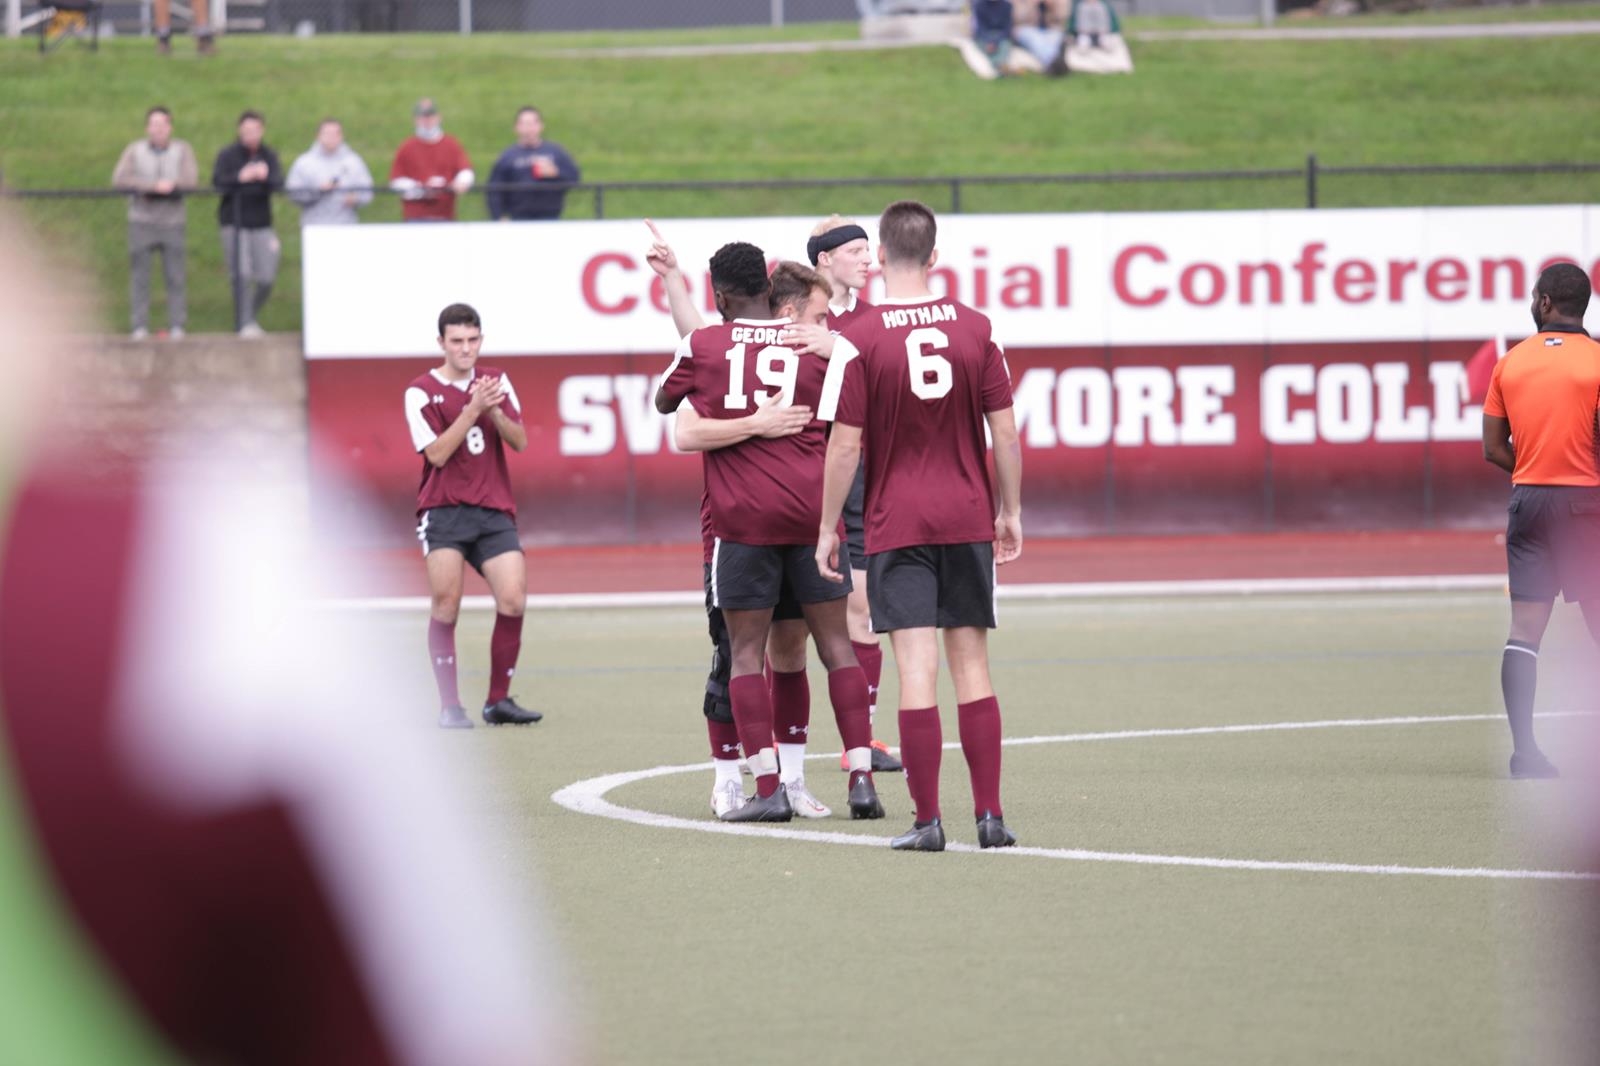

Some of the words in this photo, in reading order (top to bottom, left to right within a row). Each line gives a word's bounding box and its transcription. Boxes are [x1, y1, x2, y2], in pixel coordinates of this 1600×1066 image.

[581, 246, 1070, 314] Cenial
[1112, 243, 1600, 308] Conferen
[731, 326, 797, 346] GEORG
[881, 304, 957, 329] HOTHAM
[724, 343, 799, 410] 19
[905, 327, 953, 400] 6
[466, 426, 486, 455] 8
[558, 364, 1236, 455] SWMORE
[1260, 361, 1485, 444] COLL
